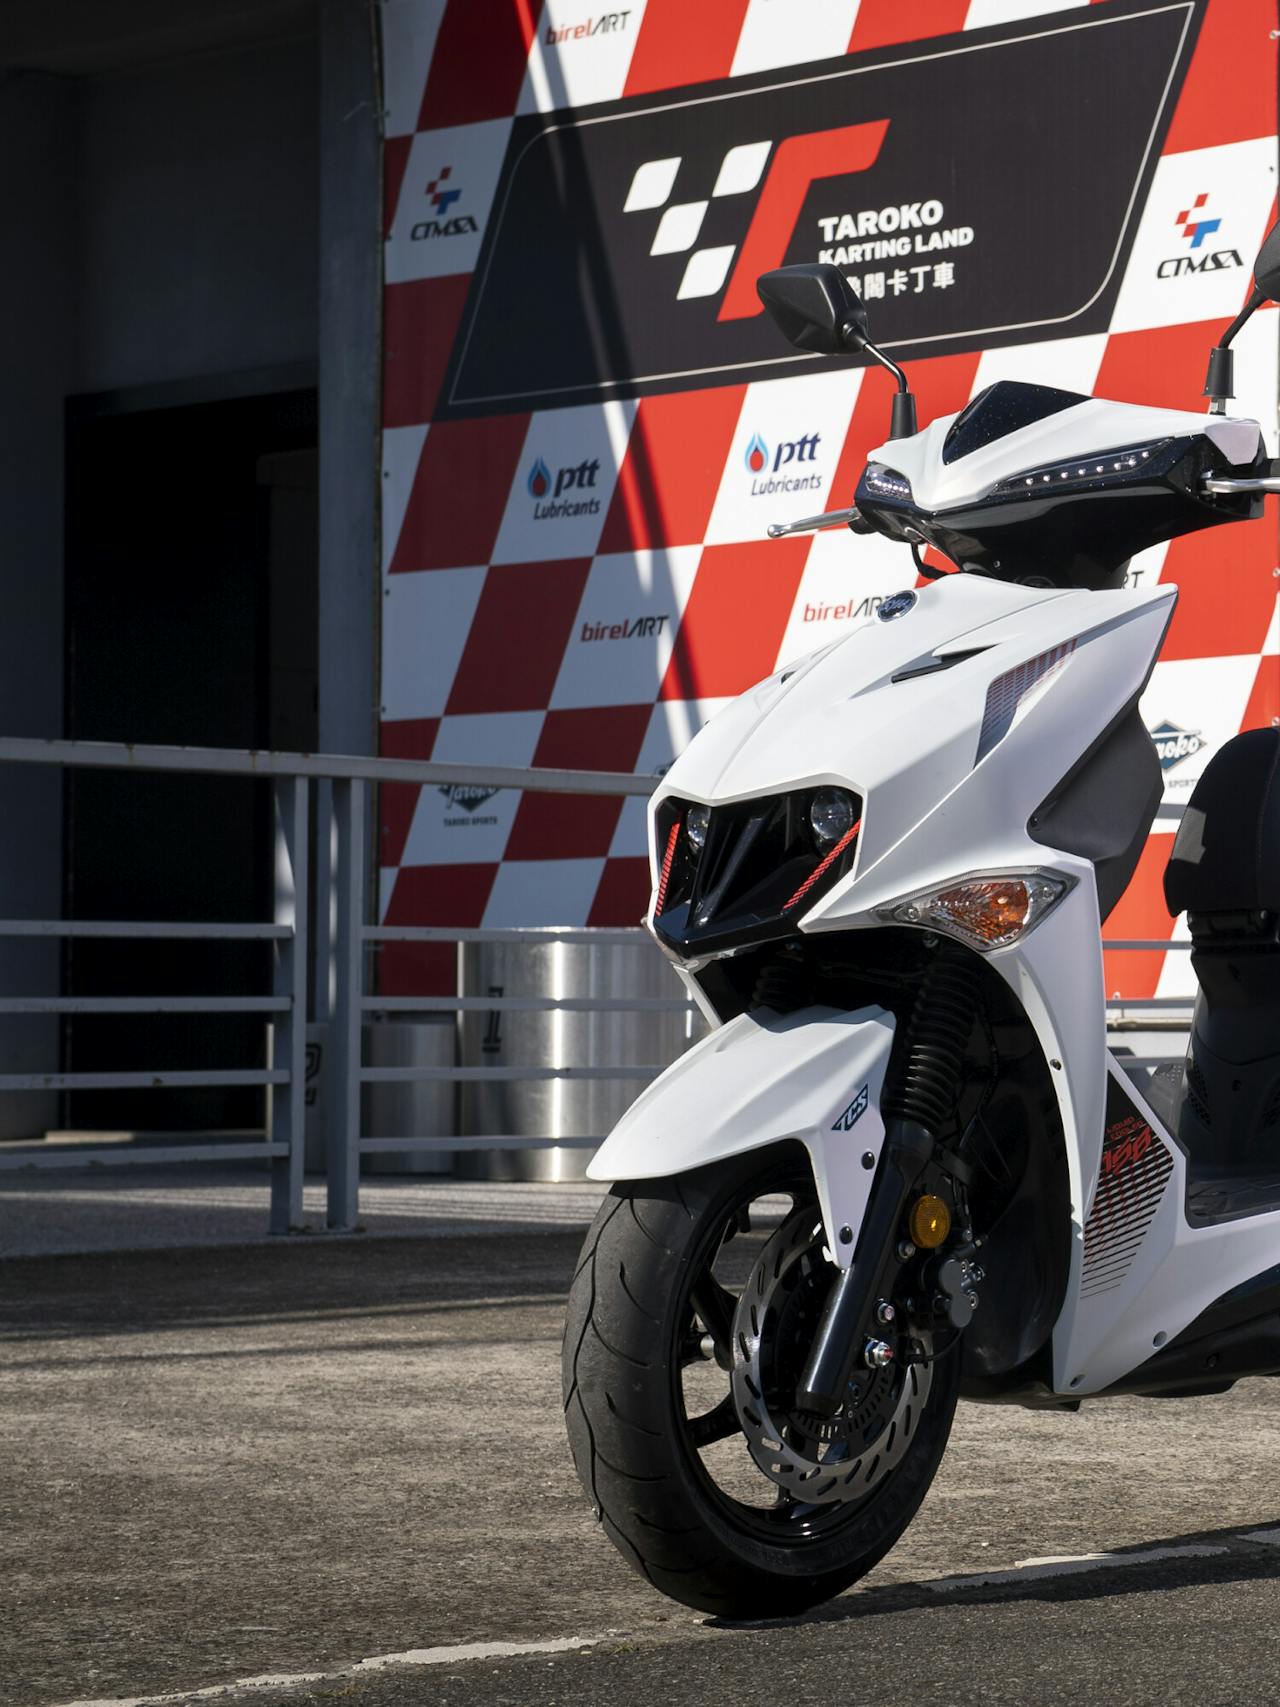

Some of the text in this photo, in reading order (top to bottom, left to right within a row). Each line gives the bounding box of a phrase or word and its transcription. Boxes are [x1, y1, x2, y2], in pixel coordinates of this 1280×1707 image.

[545, 10, 632, 46] birelART
[411, 215, 478, 241] CTMSA
[817, 200, 944, 242] TAROKO
[818, 227, 974, 267] KARTING LAND
[1157, 249, 1244, 279] CTMSA
[773, 432, 821, 472] ptt
[554, 459, 600, 498] ptt
[752, 474, 821, 496] Lubricants
[534, 498, 600, 520] Lubricants
[803, 595, 890, 622] birelAR
[581, 615, 669, 643] birelART
[1168, 778, 1200, 789] SPORT
[832, 1083, 868, 1131] TCS
